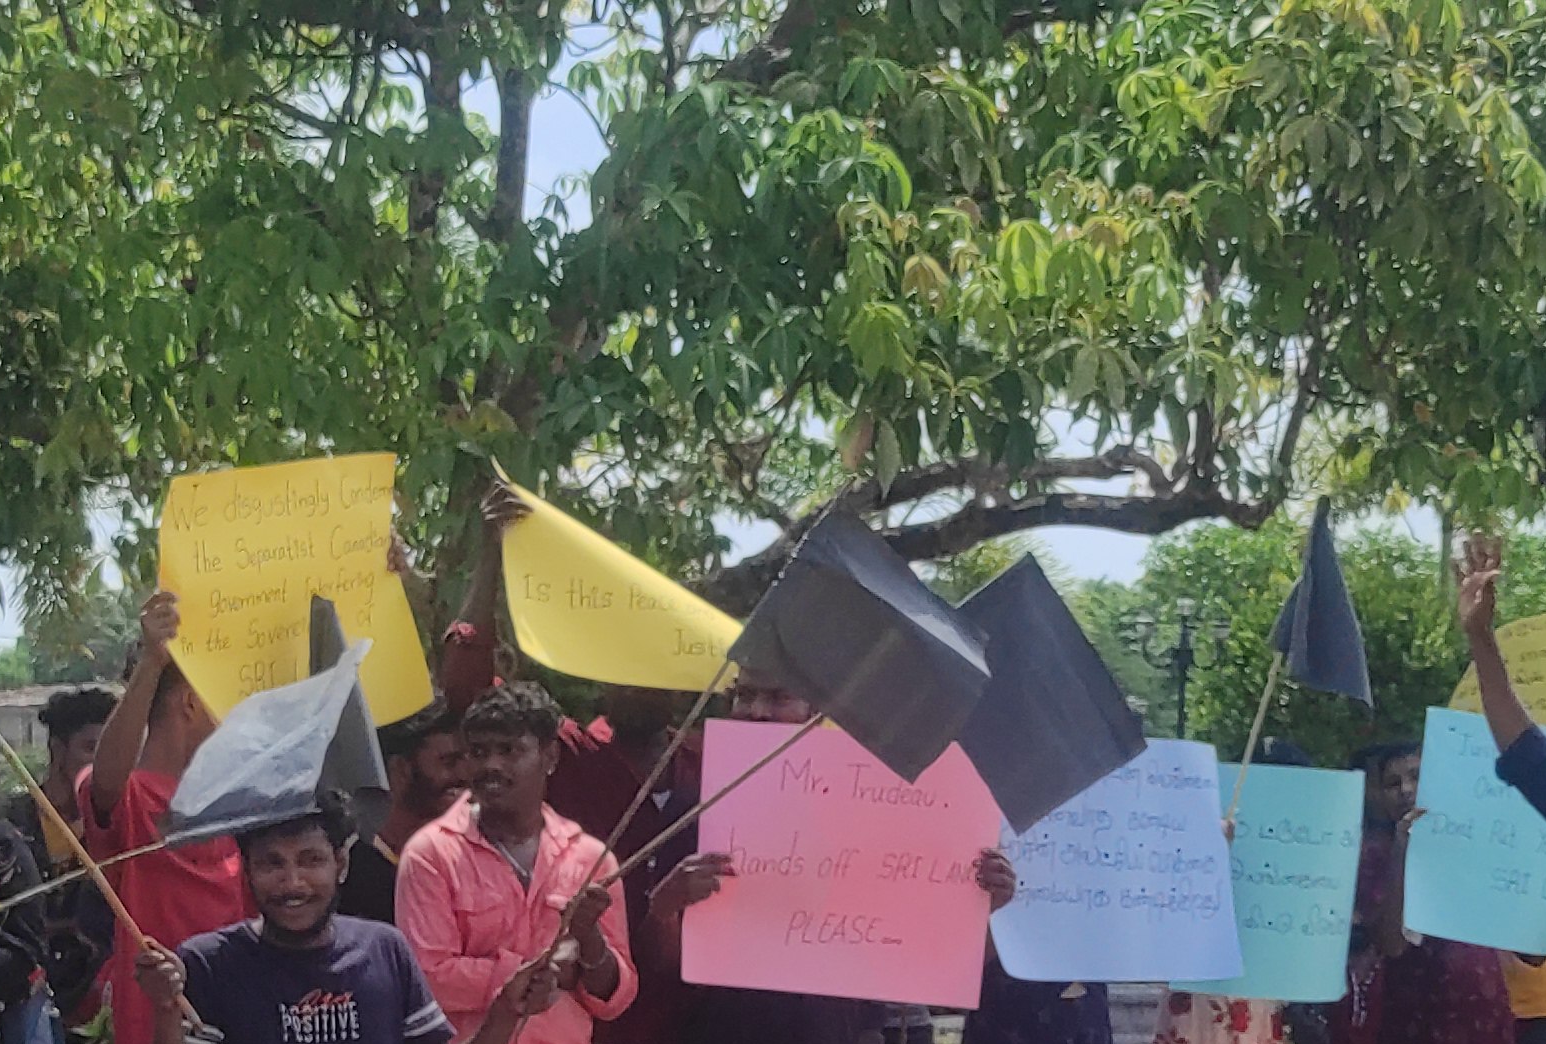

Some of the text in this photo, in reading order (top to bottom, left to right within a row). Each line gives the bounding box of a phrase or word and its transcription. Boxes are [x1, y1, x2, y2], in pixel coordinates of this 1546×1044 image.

[171, 484, 208, 531] We
[195, 539, 223, 575] the
[523, 572, 552, 603] Is
[564, 575, 614, 610] this
[205, 629, 231, 654] the
[780, 757, 831, 797] Mr.
[817, 848, 860, 880] off
[877, 852, 924, 884] SRI
